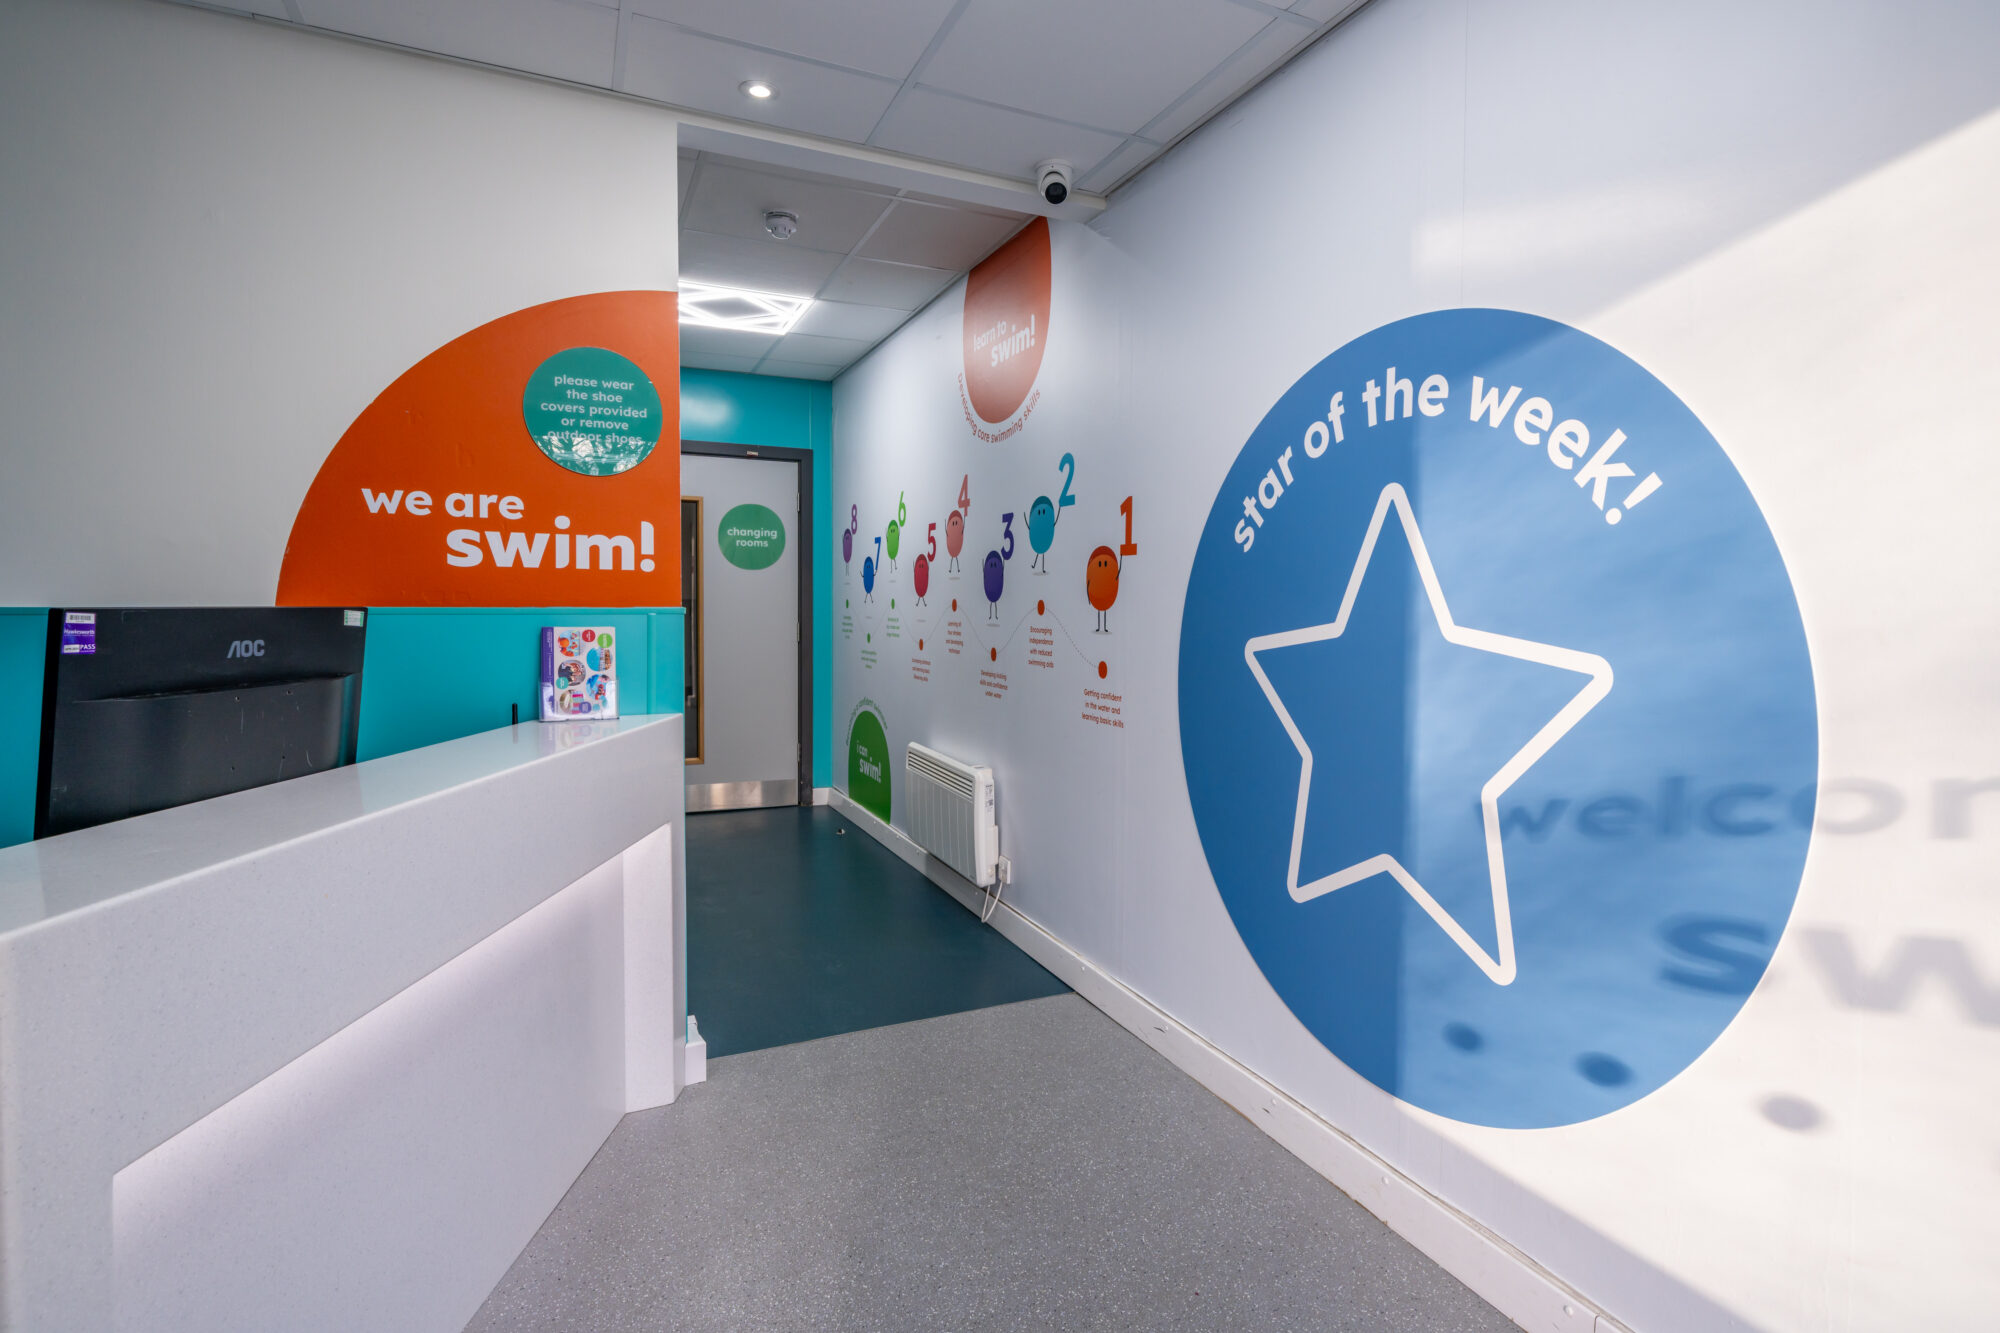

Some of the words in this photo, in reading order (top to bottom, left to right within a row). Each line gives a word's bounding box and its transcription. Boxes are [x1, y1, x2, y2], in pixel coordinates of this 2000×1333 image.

[973, 326, 996, 352] learn
[996, 320, 1007, 337] to
[991, 314, 1035, 367] swim!
[554, 374, 598, 388] please
[602, 379, 635, 391] wear
[566, 389, 588, 400] the
[592, 391, 623, 403] shoe
[540, 402, 585, 414] covers
[589, 406, 648, 419] provided
[561, 417, 575, 427] or
[579, 418, 629, 430] remove
[978, 429, 990, 443] core
[991, 417, 1023, 443] swimming
[1023, 389, 1040, 421] skills
[1234, 445, 1294, 553] star
[1303, 390, 1345, 459] of
[1361, 366, 1449, 427] the
[1469, 375, 1664, 525] week!
[957, 474, 971, 517] 4
[1058, 452, 1076, 507] 2
[361, 488, 433, 516] we
[445, 492, 525, 520] are
[851, 503, 858, 535] 8
[898, 491, 906, 528] 6
[727, 527, 778, 540] changing
[1001, 512, 1015, 561] 3
[1119, 495, 1138, 556] 1
[446, 515, 656, 573] swim!
[736, 538, 769, 548] rooms
[874, 536, 883, 571] 7
[927, 522, 937, 563] 5
[227, 640, 265, 658] AOC
[1084, 688, 1100, 700] Getting
[1100, 692, 1122, 702] confident
[1098, 705, 1110, 713] water
[1111, 707, 1121, 715] and
[1081, 711, 1100, 725] learning
[1100, 716, 1112, 726] basic
[1112, 719, 1124, 729] skills
[859, 756, 882, 784] swim!
